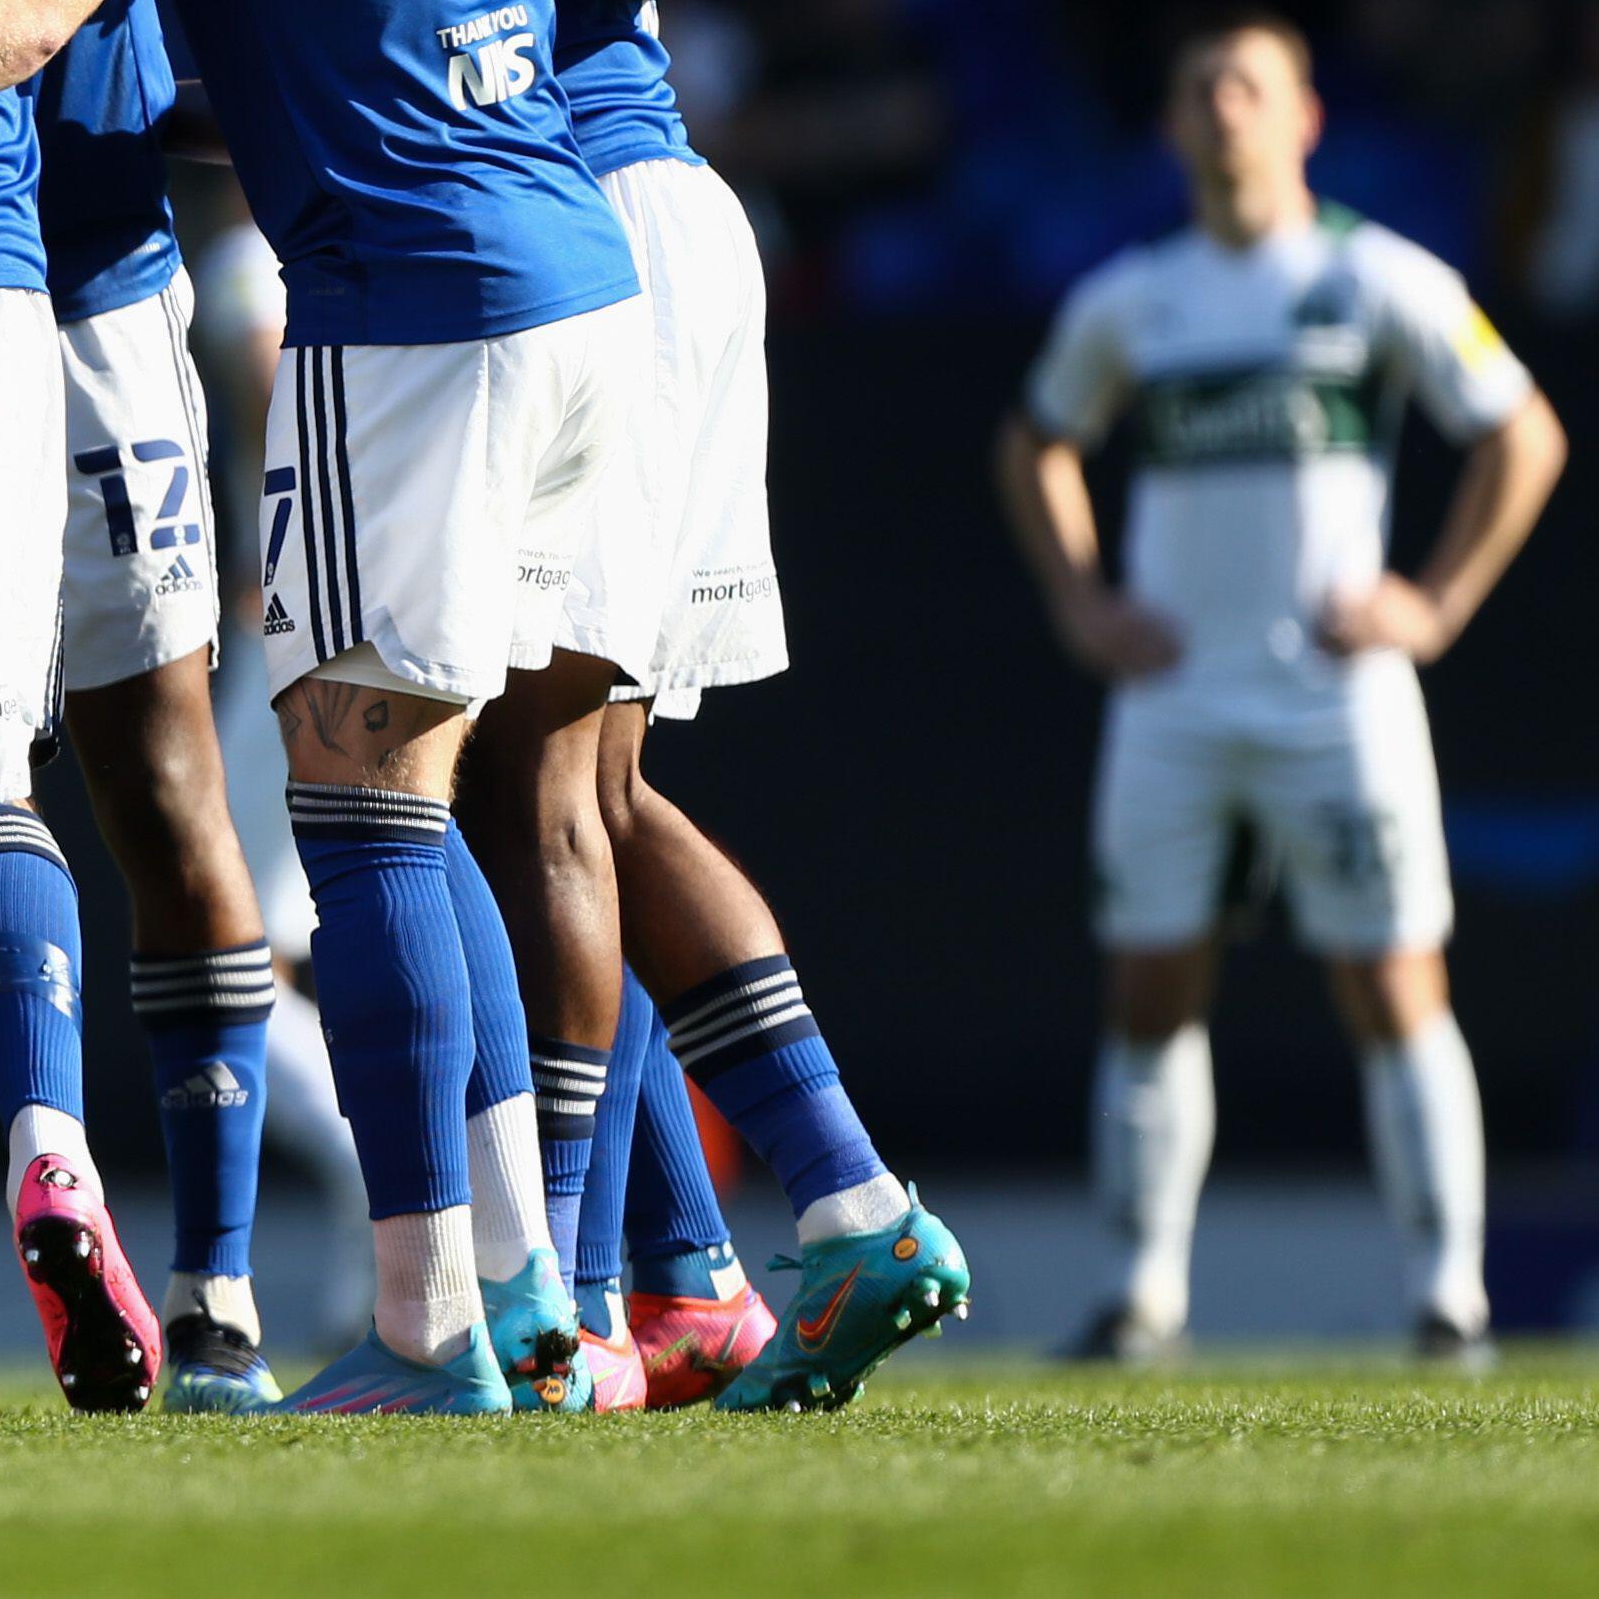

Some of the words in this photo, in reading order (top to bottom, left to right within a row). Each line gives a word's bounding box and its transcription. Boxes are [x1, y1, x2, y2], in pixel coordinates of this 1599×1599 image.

[73, 439, 200, 557] 12
[517, 564, 571, 591] ortgag
[691, 576, 775, 604] mortgag
